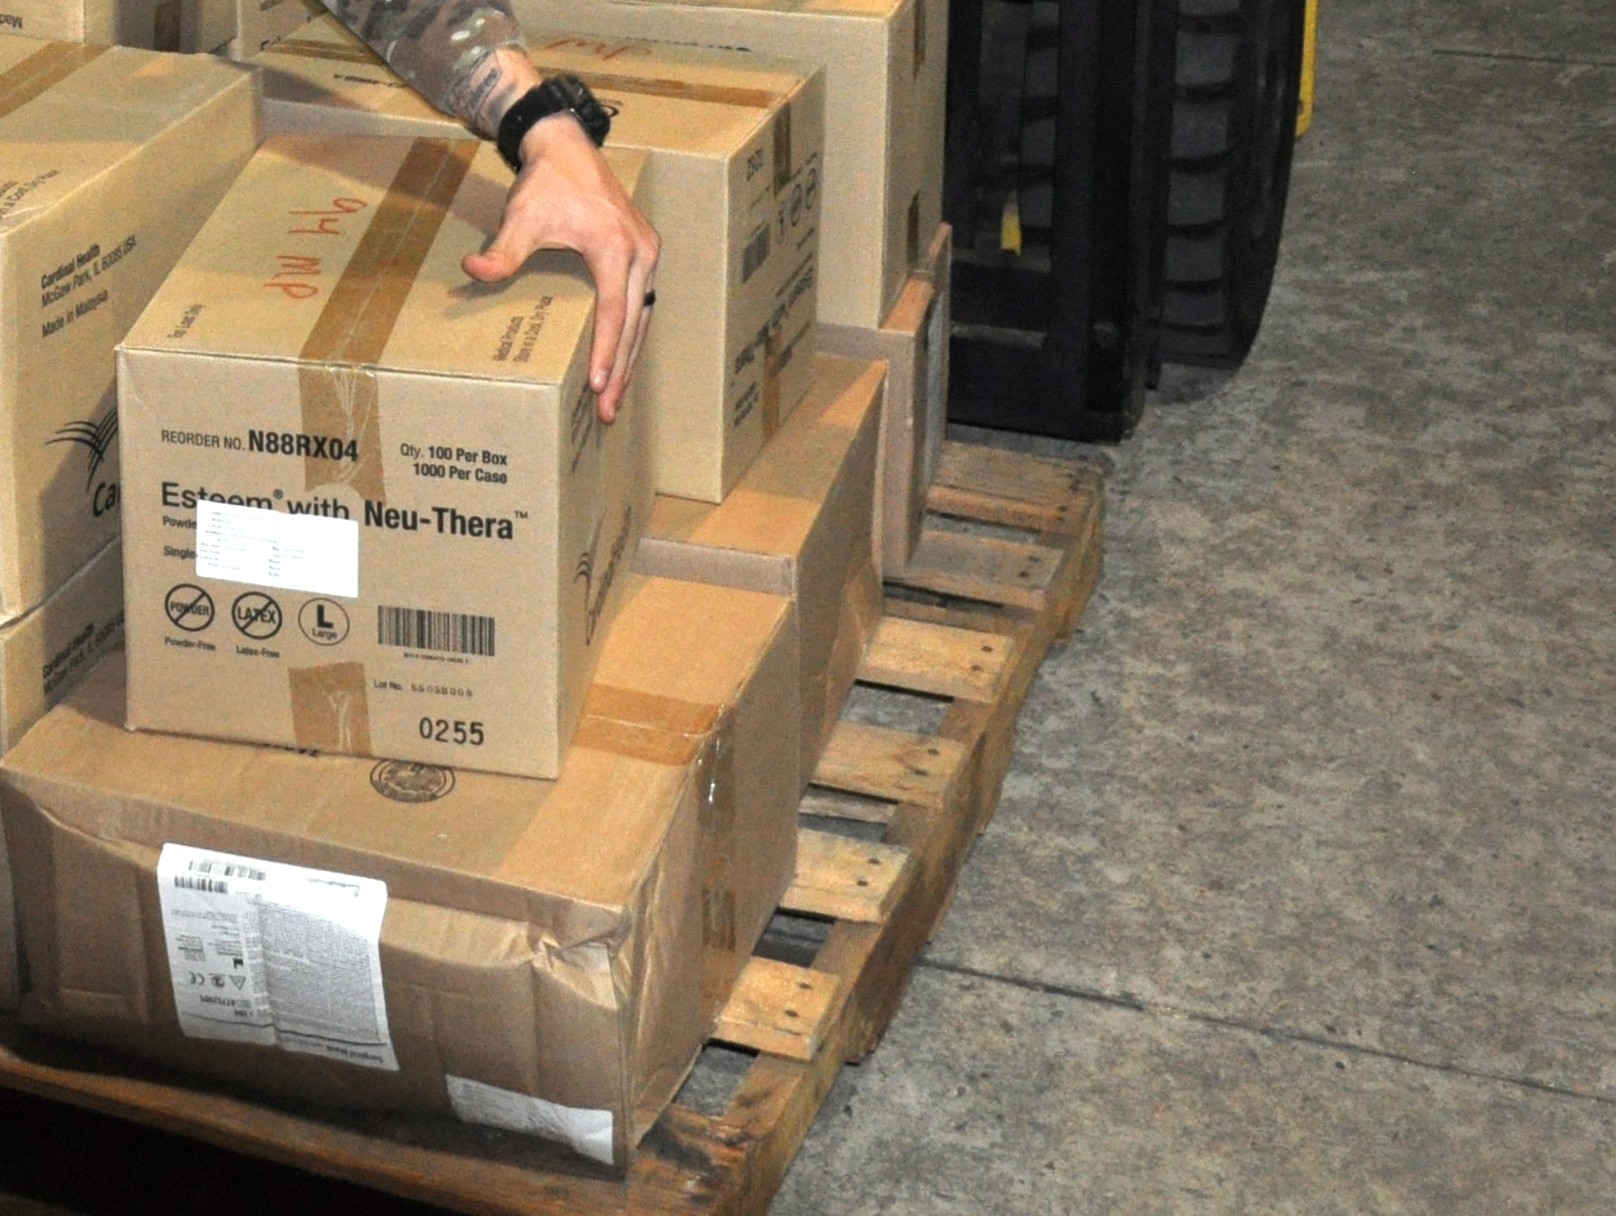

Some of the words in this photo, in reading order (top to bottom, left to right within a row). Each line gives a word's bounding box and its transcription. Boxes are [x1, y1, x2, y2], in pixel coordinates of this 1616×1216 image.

[161, 429, 220, 449] REORDER
[224, 435, 245, 451] NO.
[248, 429, 359, 461] N88RX04
[400, 443, 424, 459] Qty.
[428, 445, 452, 461] 100
[456, 448, 479, 464] Per
[482, 450, 508, 466] Box
[413, 462, 445, 478] 1000
[449, 465, 471, 481] Per
[475, 468, 508, 484] Case
[287, 497, 349, 520] with
[170, 601, 210, 616] POWDER
[238, 606, 277, 624] LATEX
[317, 604, 333, 629] L
[164, 636, 216, 652] Powder-Free
[312, 628, 337, 641] Large
[236, 645, 280, 659] Latex-Free
[419, 717, 485, 746] 0255
